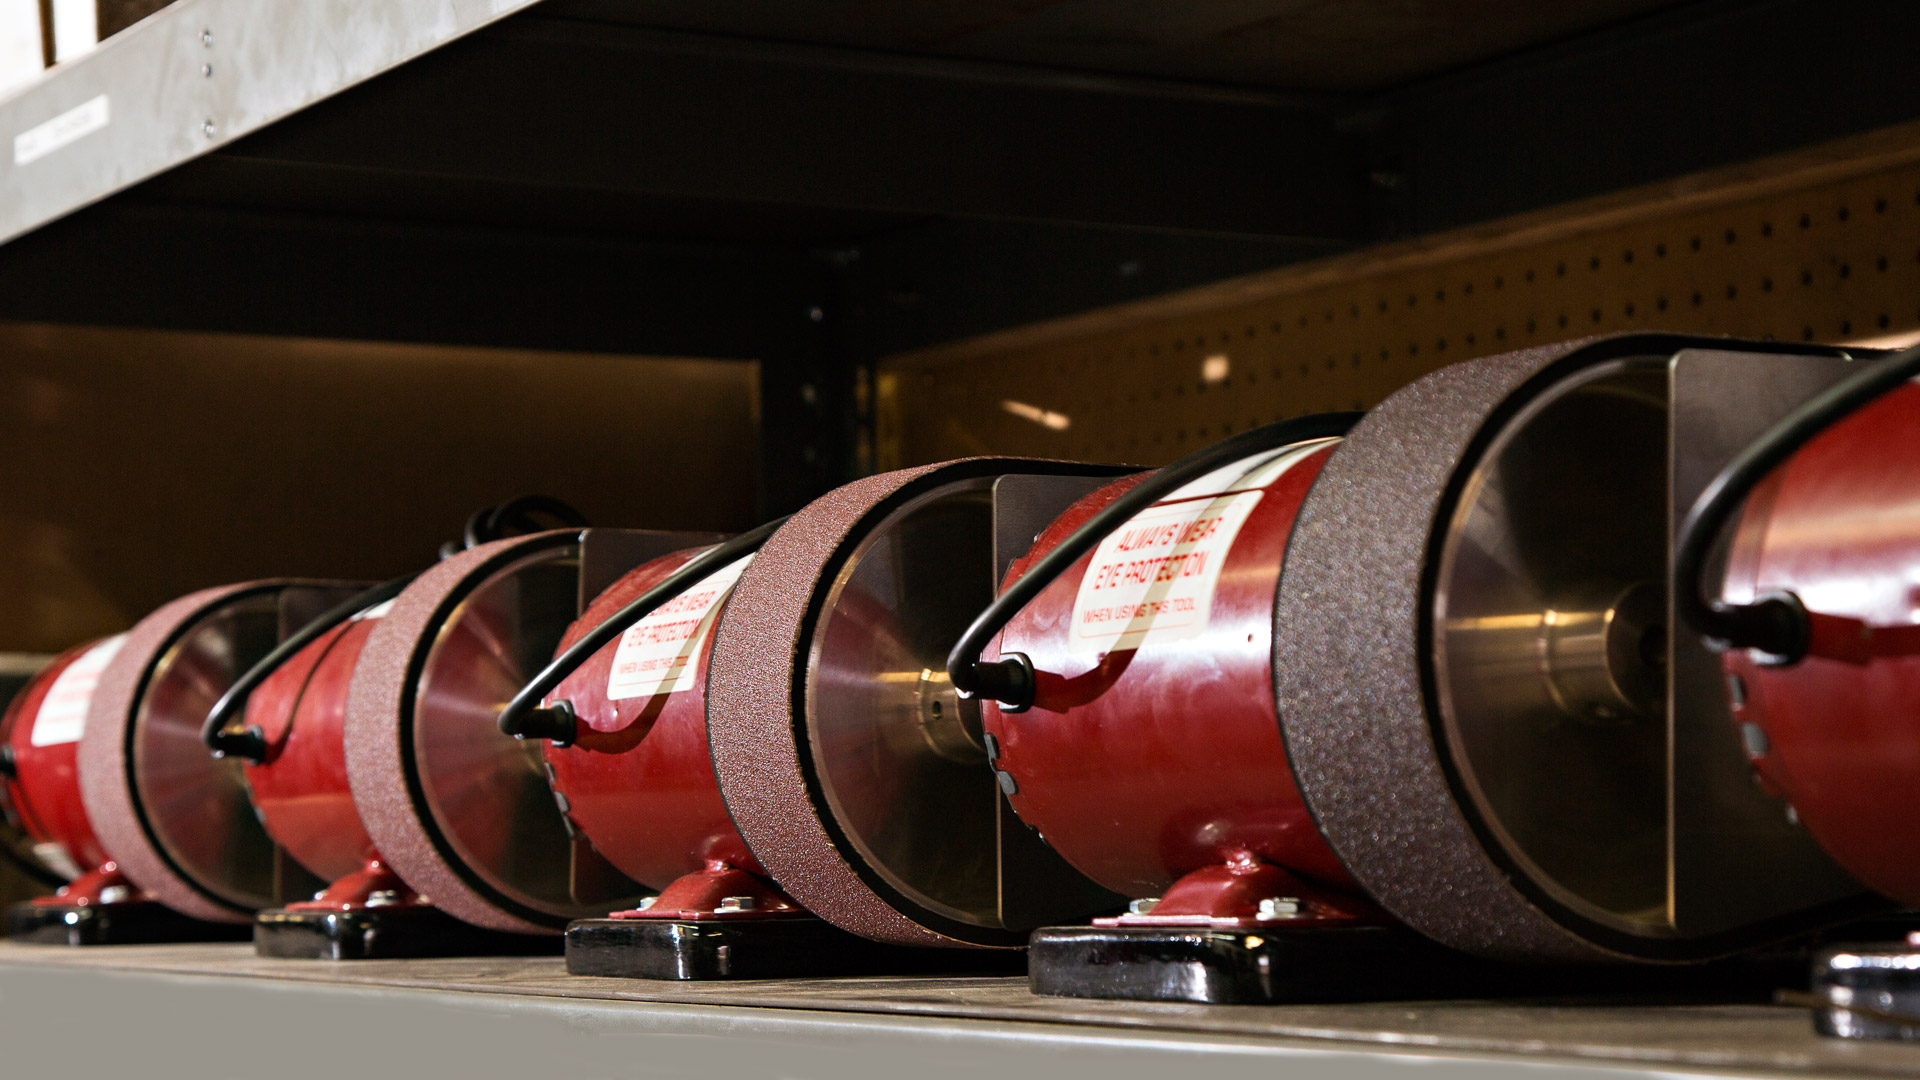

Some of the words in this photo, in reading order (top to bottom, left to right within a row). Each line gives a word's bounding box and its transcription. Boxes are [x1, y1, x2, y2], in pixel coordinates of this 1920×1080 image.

[1115, 523, 1178, 551] ALWAYS
[1175, 517, 1223, 544] WEAR
[1094, 560, 1124, 590] EYE
[1121, 551, 1210, 586] PROTECTION
[1083, 606, 1112, 624] WHEN
[1115, 603, 1147, 619] USING
[1149, 600, 1168, 617] THIS
[1173, 597, 1196, 612] TOOL
[628, 626, 648, 647] EYE
